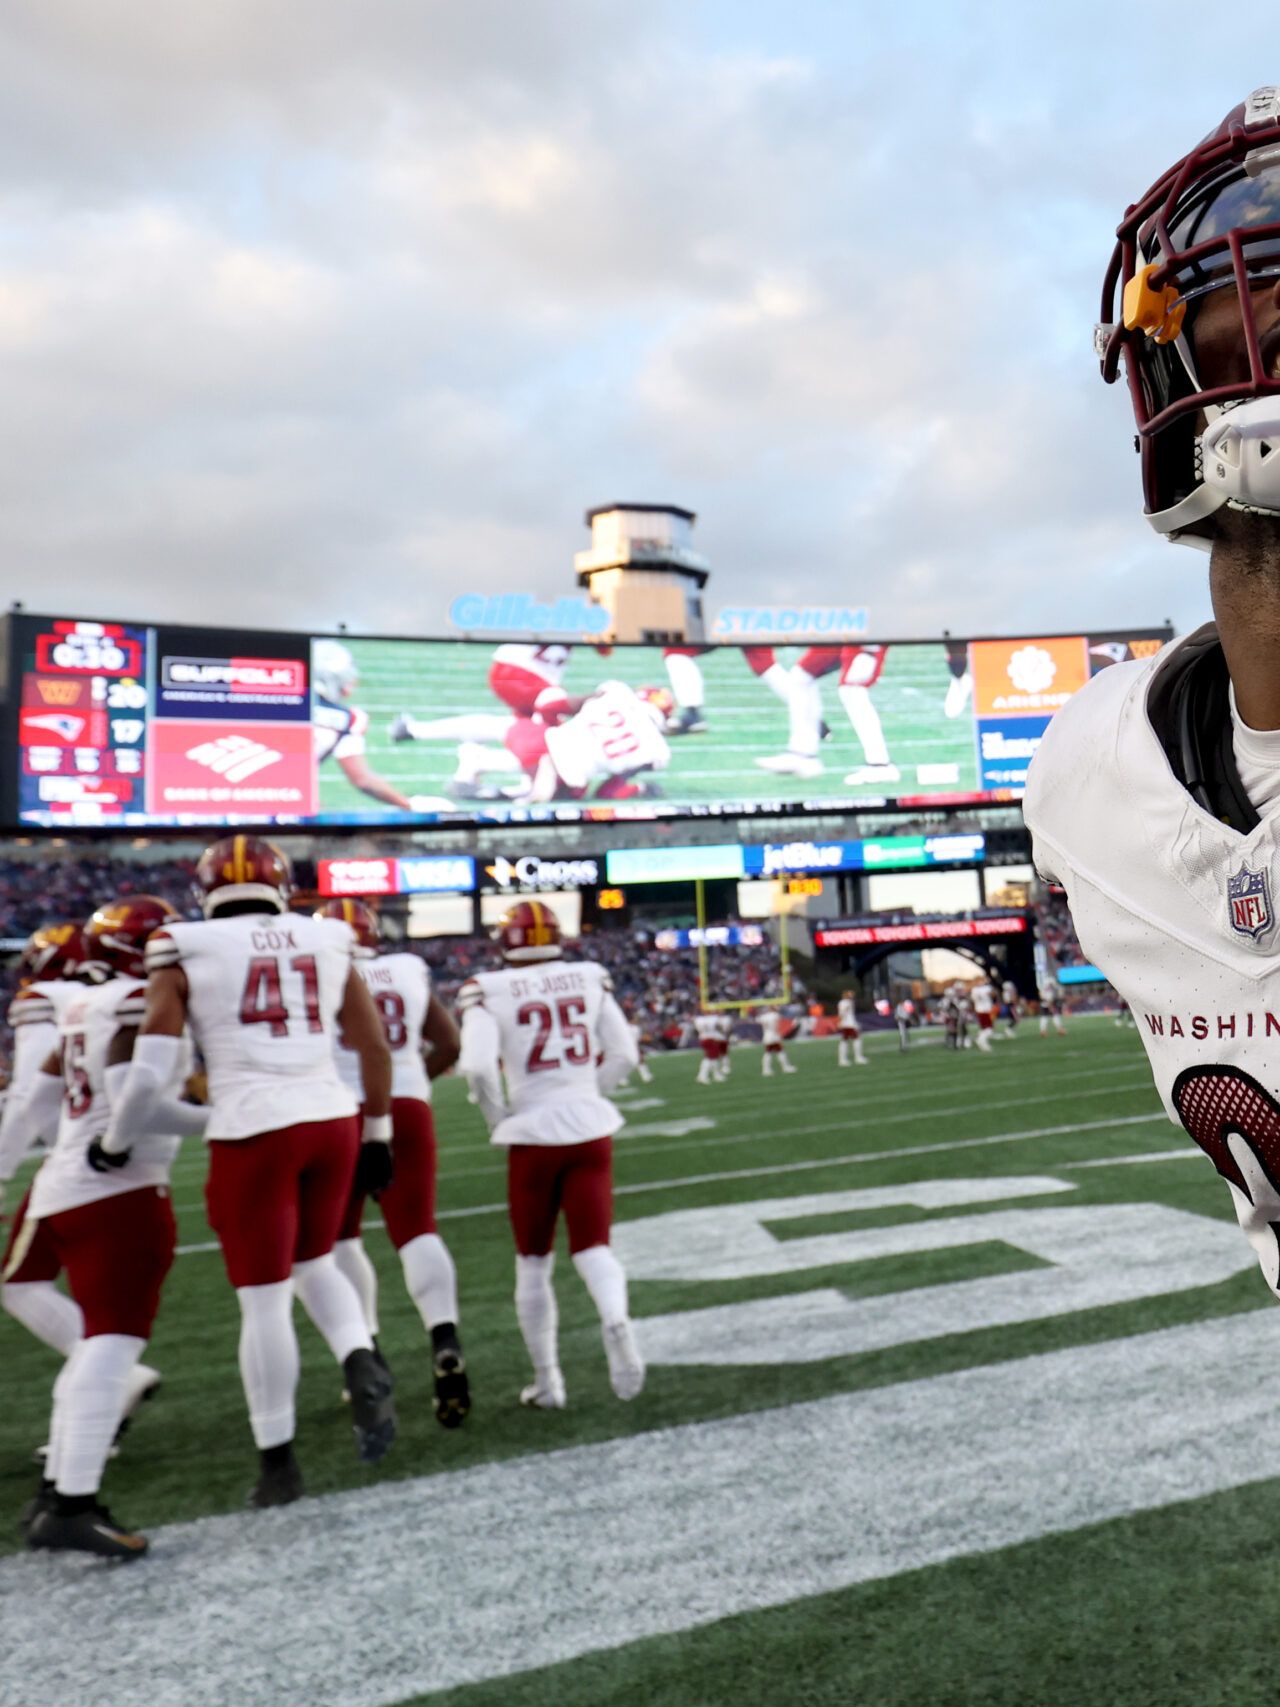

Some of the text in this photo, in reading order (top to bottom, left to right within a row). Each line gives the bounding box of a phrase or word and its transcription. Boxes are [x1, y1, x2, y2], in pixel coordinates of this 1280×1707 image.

[449, 593, 611, 632] Gillette
[714, 608, 868, 634] STADIUM
[763, 843, 841, 874] jetBlue
[250, 929, 298, 952] COX
[239, 955, 323, 1037] 41
[509, 972, 586, 999] ST-JUSTE
[517, 996, 592, 1073] 25
